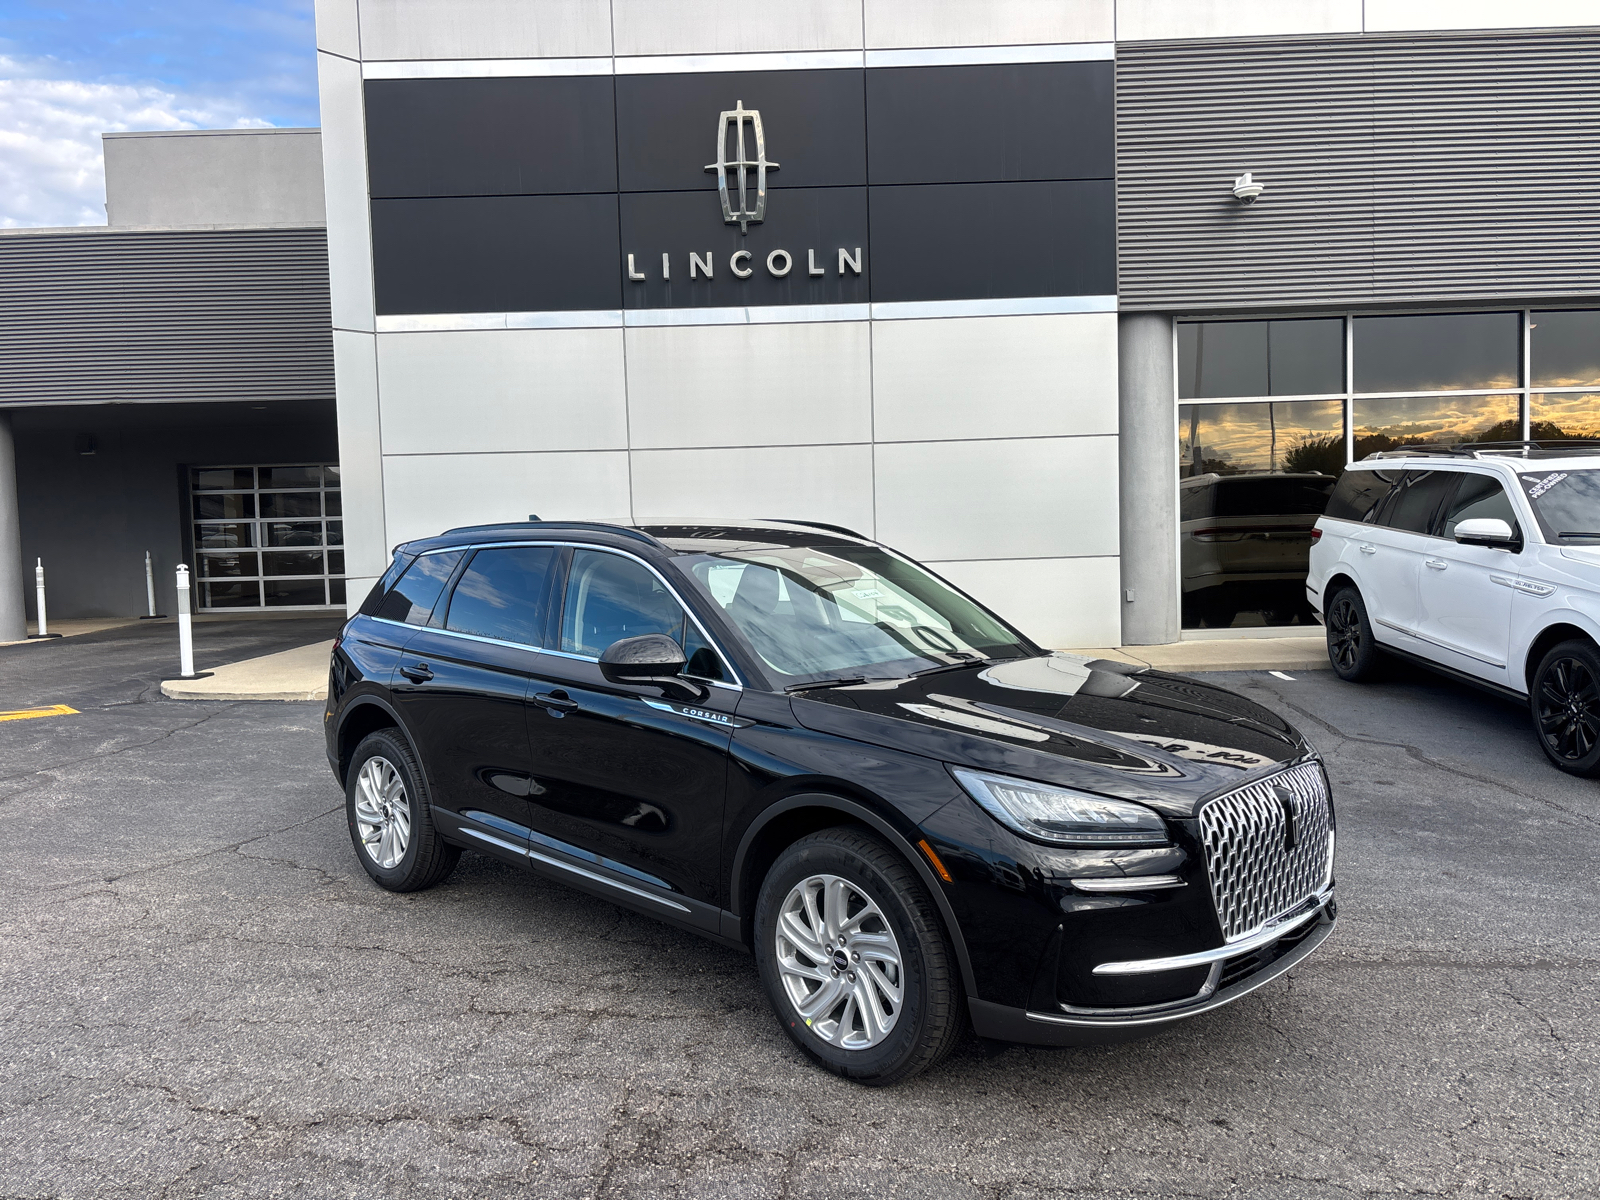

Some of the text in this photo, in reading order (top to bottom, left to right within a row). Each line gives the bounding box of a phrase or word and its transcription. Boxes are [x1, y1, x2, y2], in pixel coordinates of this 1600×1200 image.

[628, 247, 862, 281] LINCOLN
[1528, 472, 1559, 494] CERTIFIED
[682, 707, 728, 722] CORSAIR
